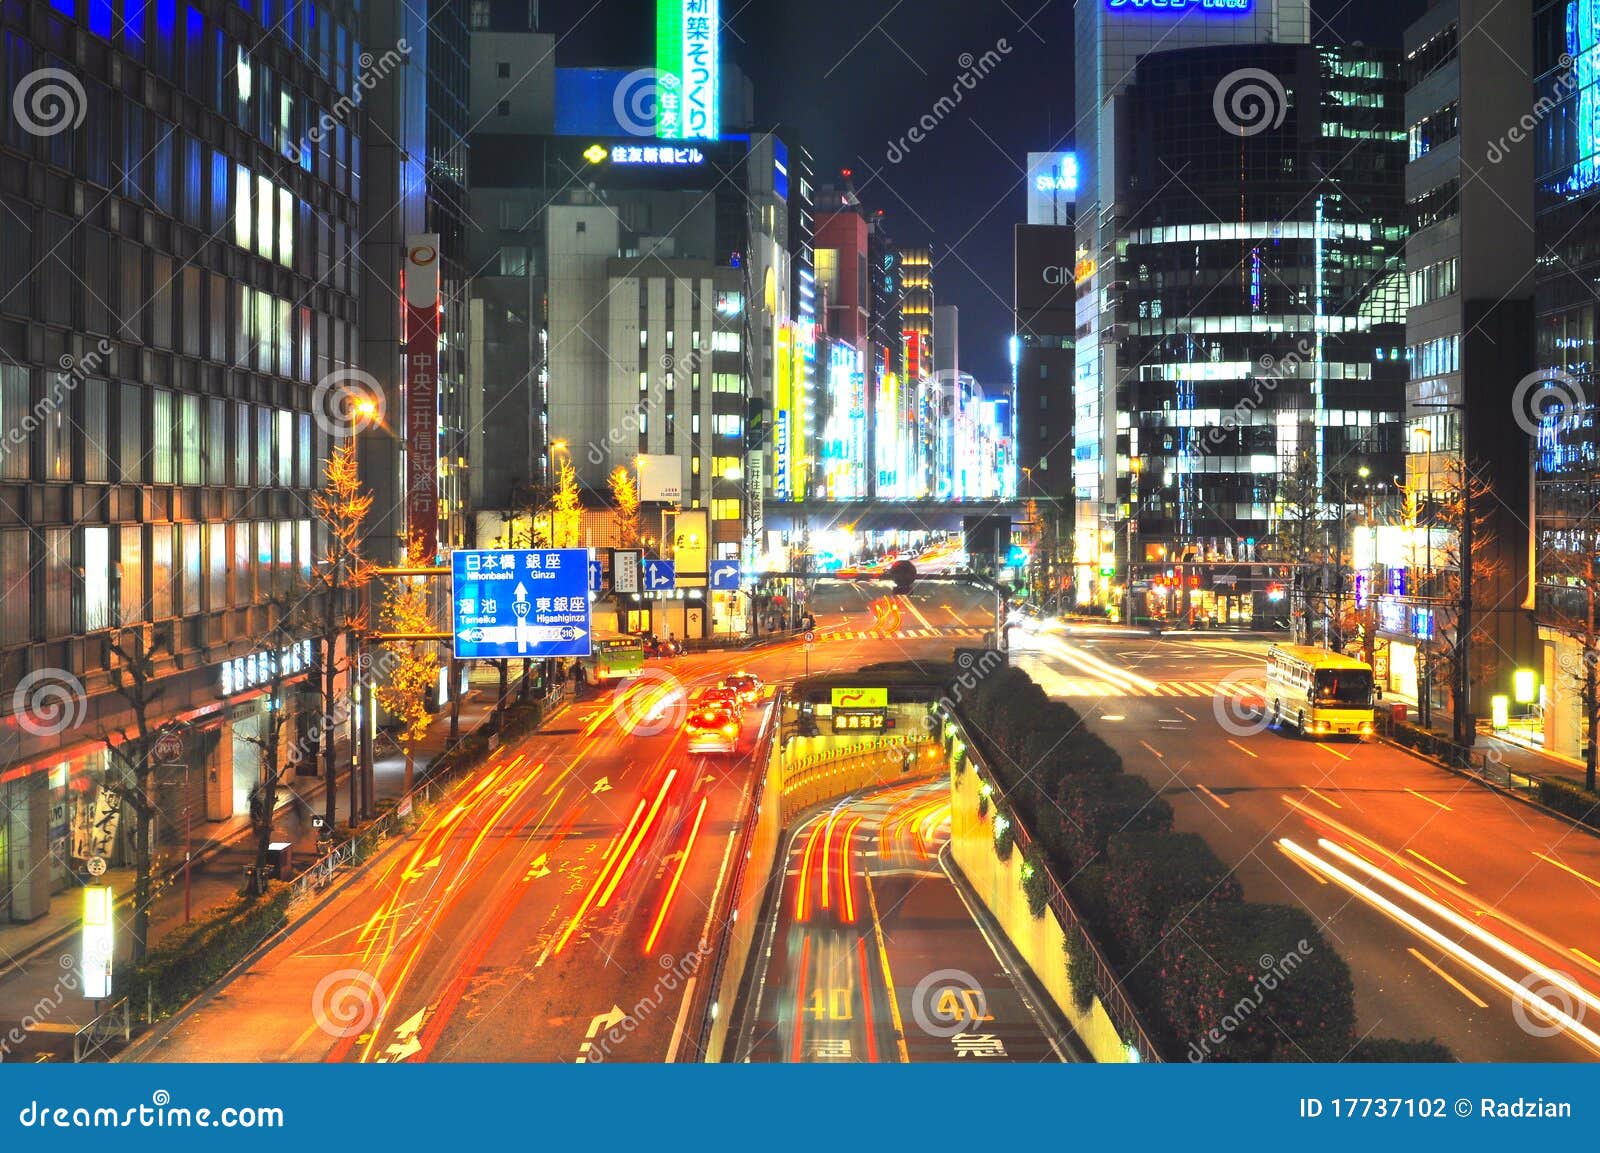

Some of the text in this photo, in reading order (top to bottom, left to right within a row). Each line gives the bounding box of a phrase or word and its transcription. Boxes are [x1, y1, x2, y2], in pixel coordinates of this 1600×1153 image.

[612, 146, 703, 163] 住友新橋ビル
[412, 352, 432, 512] 中央三井信託銀行
[466, 553, 561, 570] 日本橋 銀座
[467, 570, 555, 580] Nihonbashi Ginza
[515, 603, 527, 614] 15
[535, 596, 585, 612] 東銀座
[460, 615, 497, 624] Tameike
[536, 614, 585, 624] Higashiginza
[561, 629, 573, 638] 316
